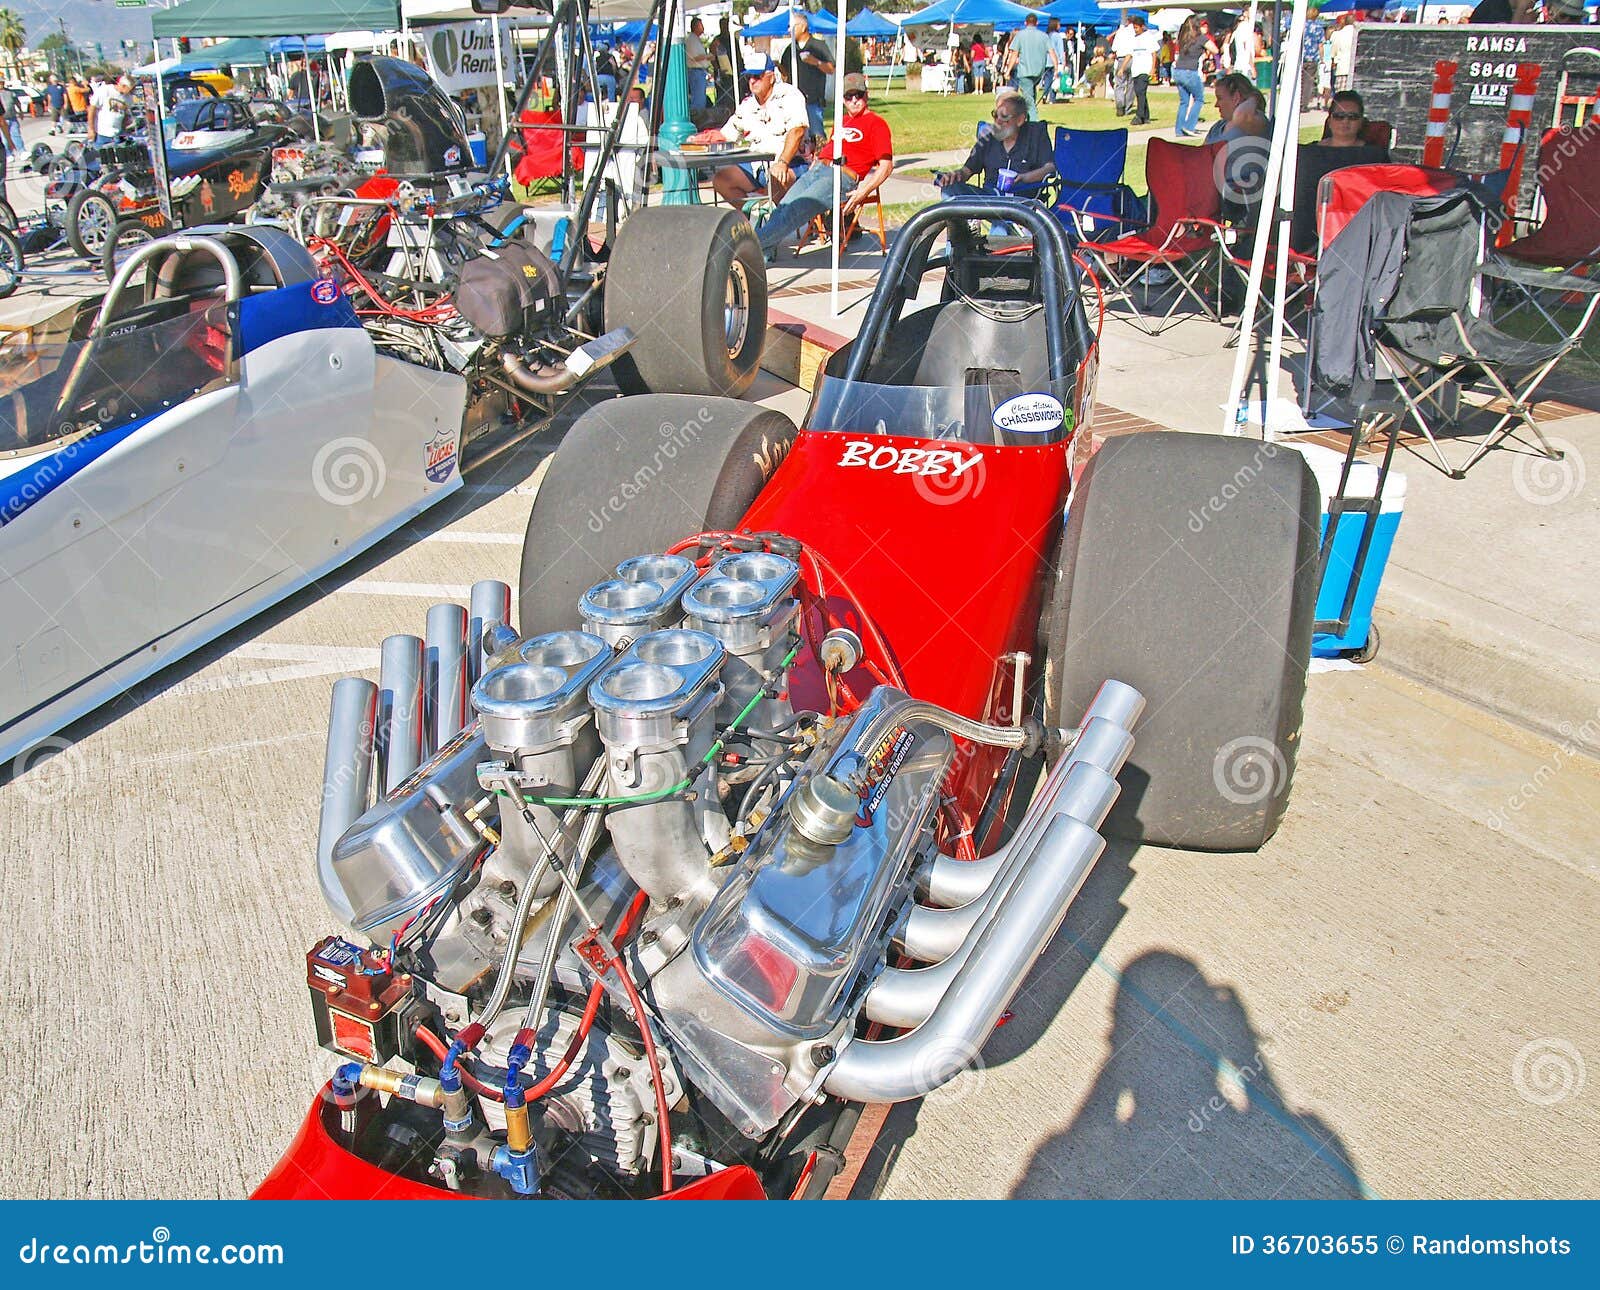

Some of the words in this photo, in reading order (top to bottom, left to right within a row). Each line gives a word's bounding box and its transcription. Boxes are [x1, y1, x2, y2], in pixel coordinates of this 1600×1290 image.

[1466, 36, 1527, 53] RAMSA
[1469, 61, 1517, 79] S840
[1001, 410, 1062, 427] CHASSISWORKS
[428, 440, 455, 467] LUCAS
[837, 441, 983, 477] BOBBY
[868, 776, 892, 814] RACING
[890, 733, 915, 775] ENGINES
